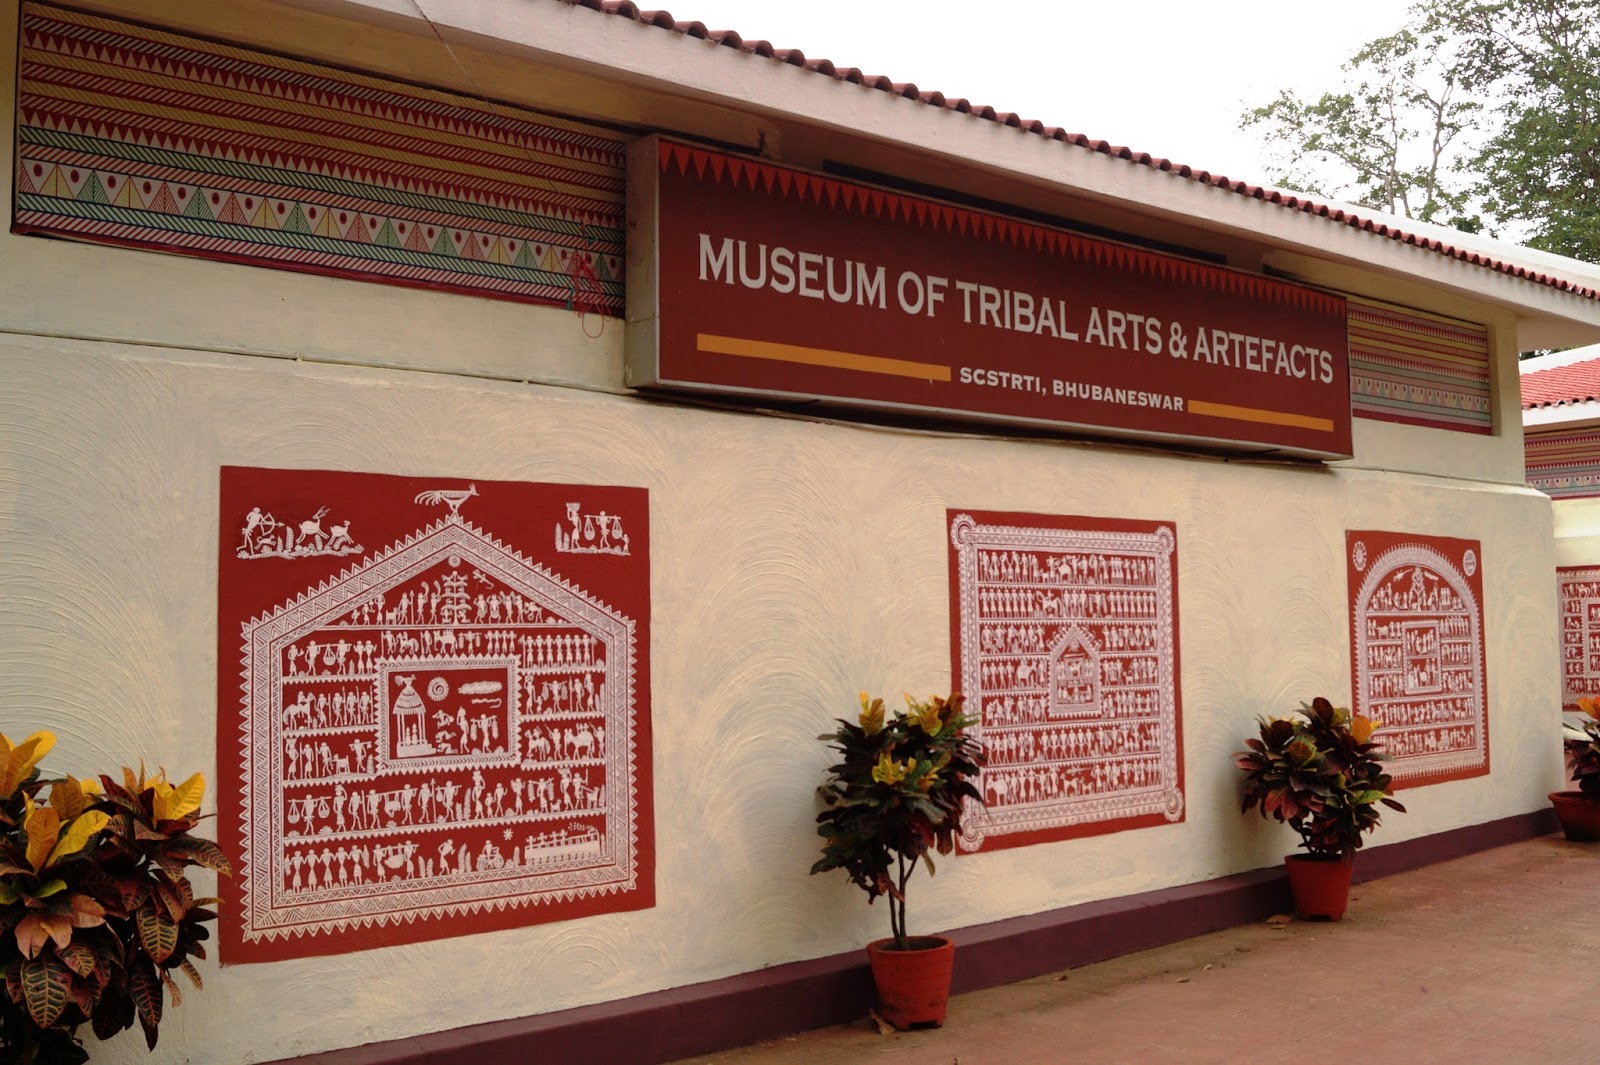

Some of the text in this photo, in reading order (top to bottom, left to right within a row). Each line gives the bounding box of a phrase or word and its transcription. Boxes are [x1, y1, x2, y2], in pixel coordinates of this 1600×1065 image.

[699, 233, 1334, 384] MUSEUM OF TRIBAL ARTS & ARTEFACTS
[959, 367, 1184, 412] SCSTRTI, BHUBANESWAR
